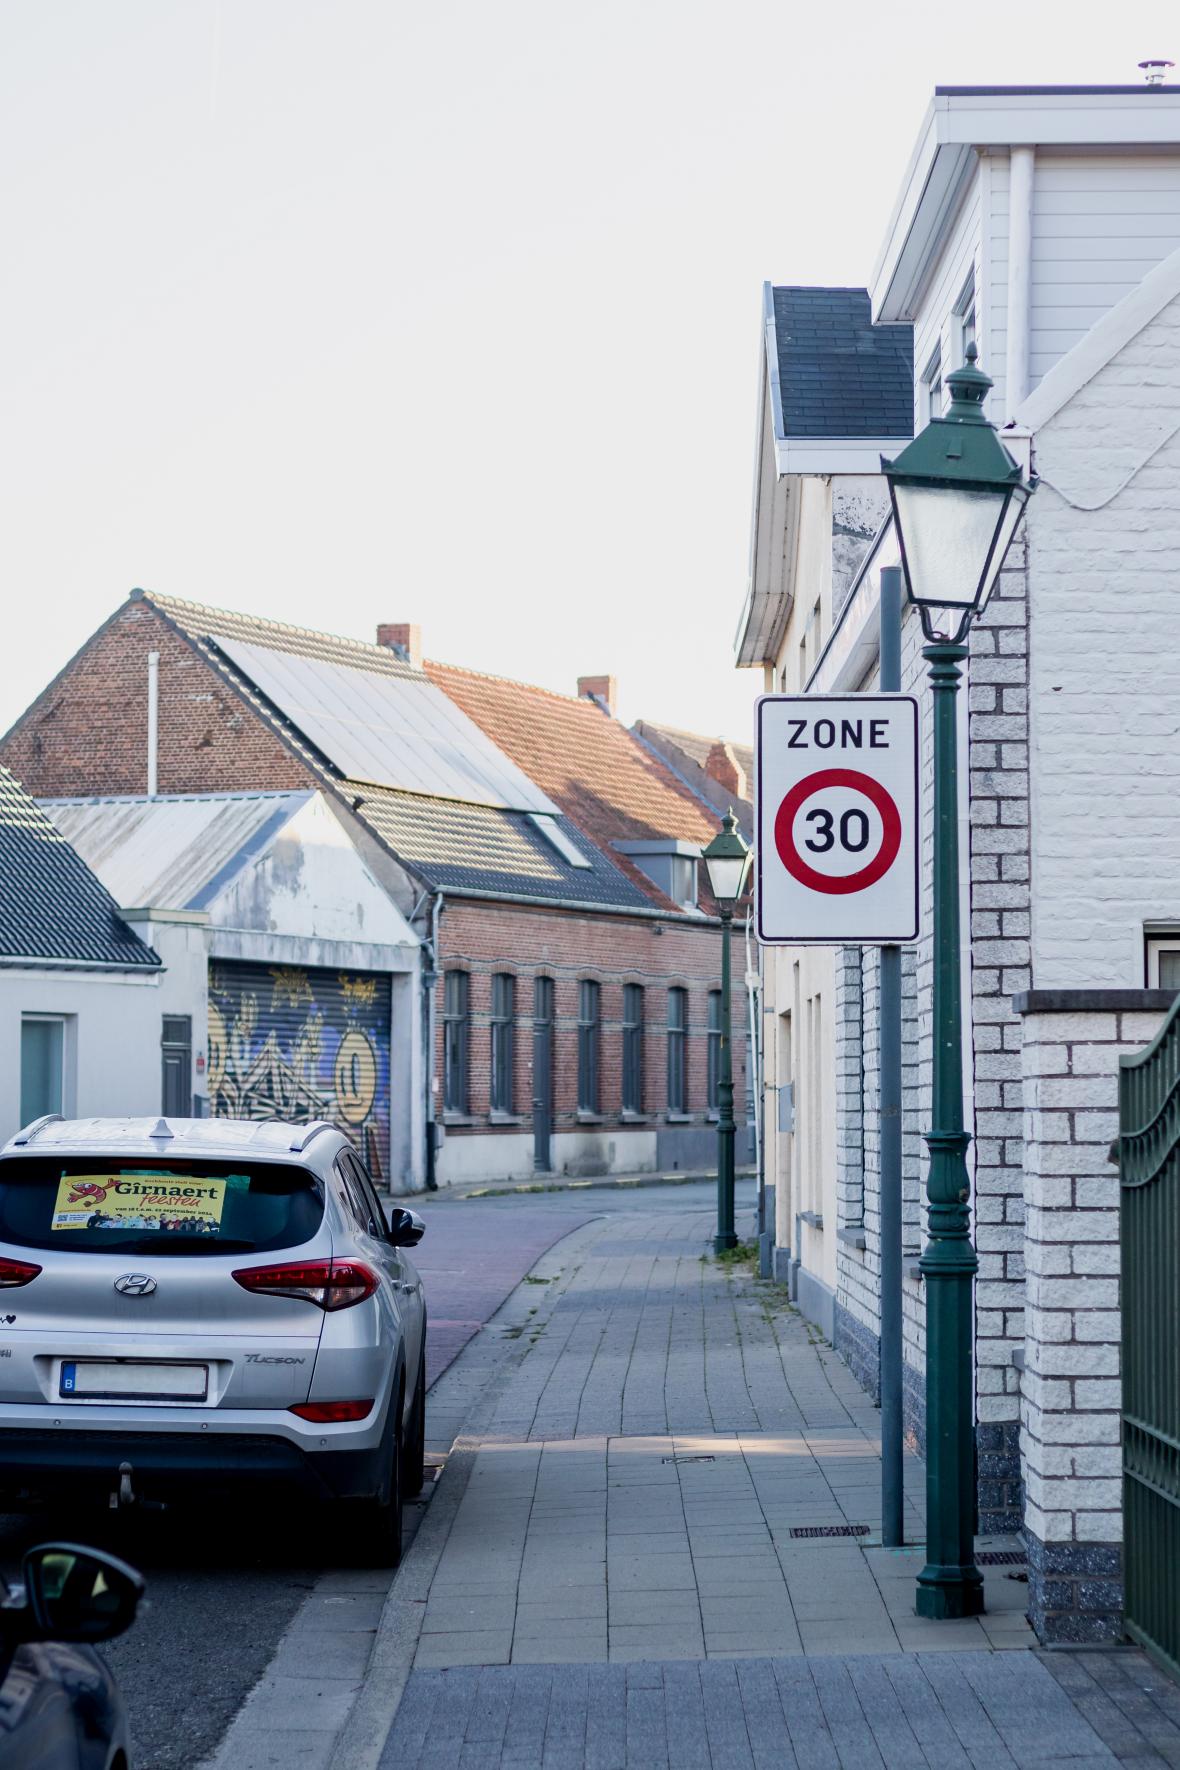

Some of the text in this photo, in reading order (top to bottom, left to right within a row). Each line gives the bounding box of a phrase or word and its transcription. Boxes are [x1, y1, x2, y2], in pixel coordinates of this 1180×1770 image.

[787, 719, 890, 749] ZONE
[804, 808, 869, 853] 30
[114, 1182, 218, 1200] Gîrnaert
[140, 1192, 201, 1208] feesten
[65, 1379, 73, 1389] B
